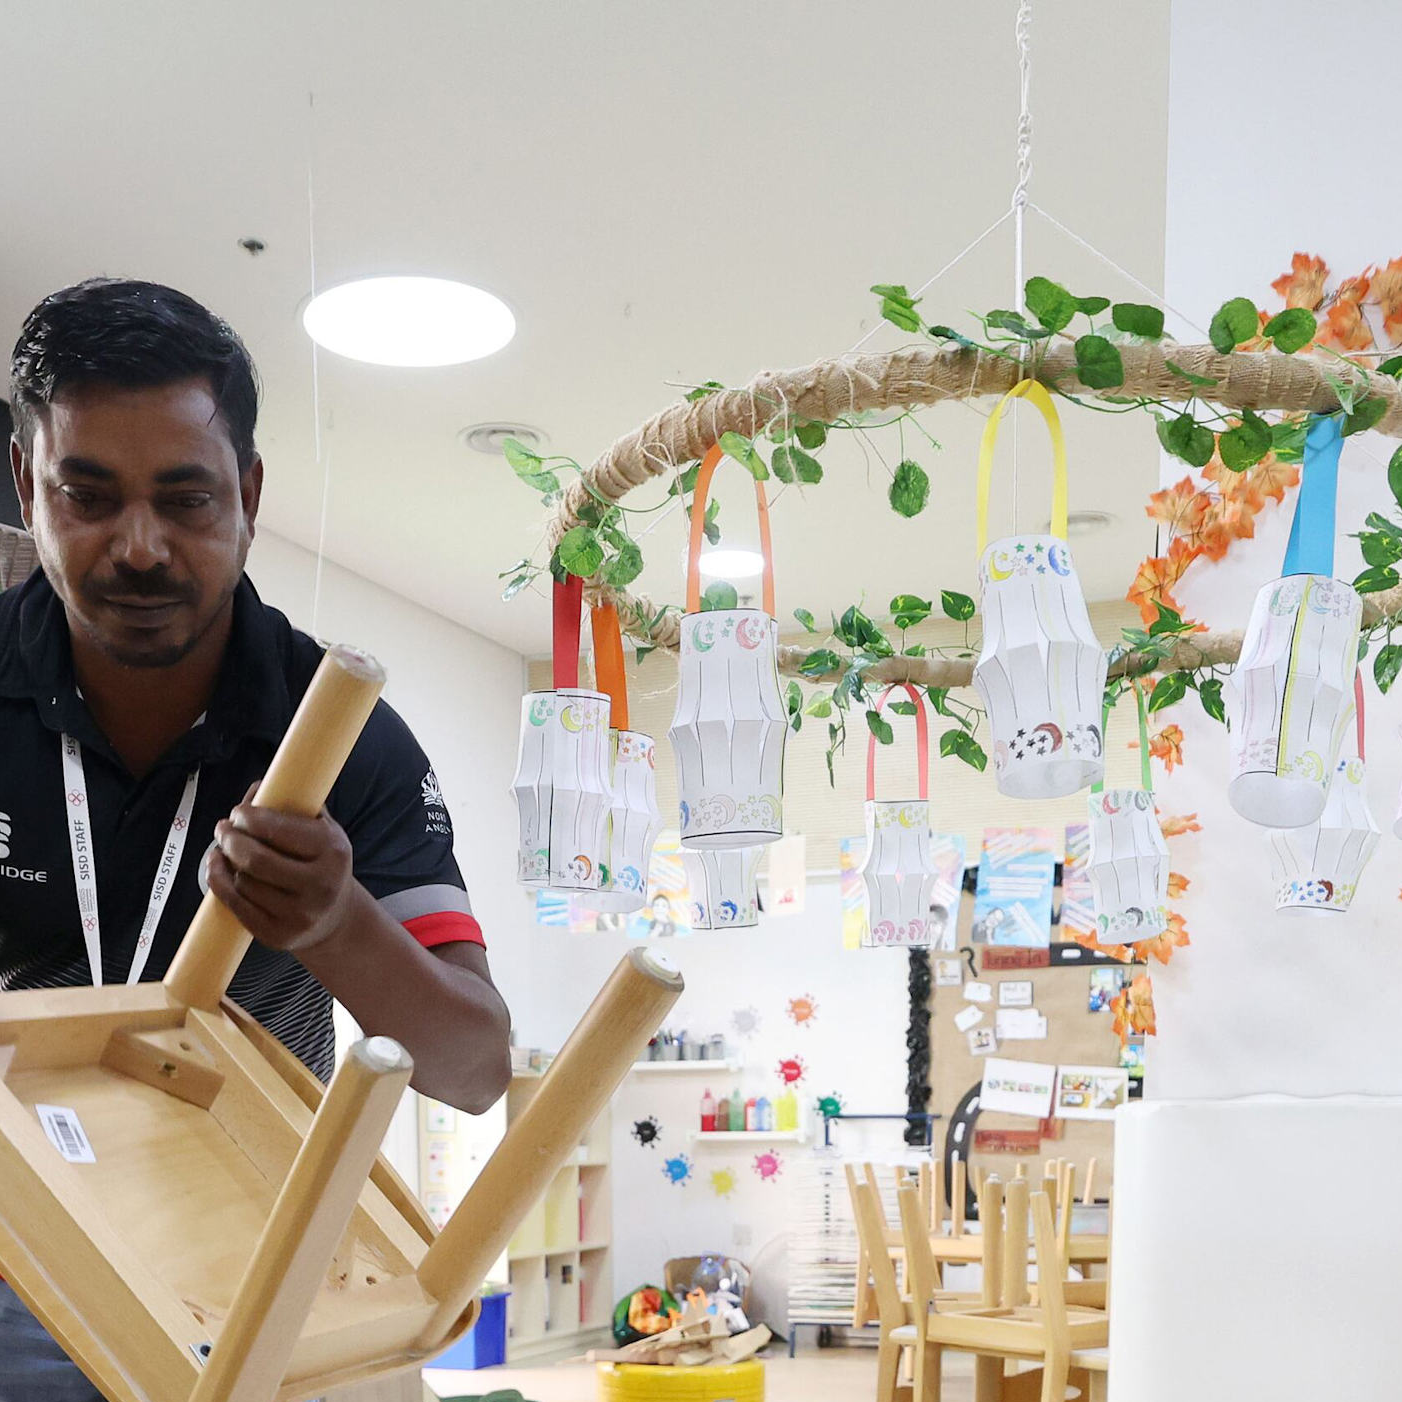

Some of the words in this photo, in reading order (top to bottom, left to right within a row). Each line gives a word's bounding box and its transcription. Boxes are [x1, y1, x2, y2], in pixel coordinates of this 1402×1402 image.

[73, 819, 87, 852] STAFF
[79, 855, 90, 881] SISD
[154, 876, 168, 901] SISD
[161, 842, 178, 874] STAFF
